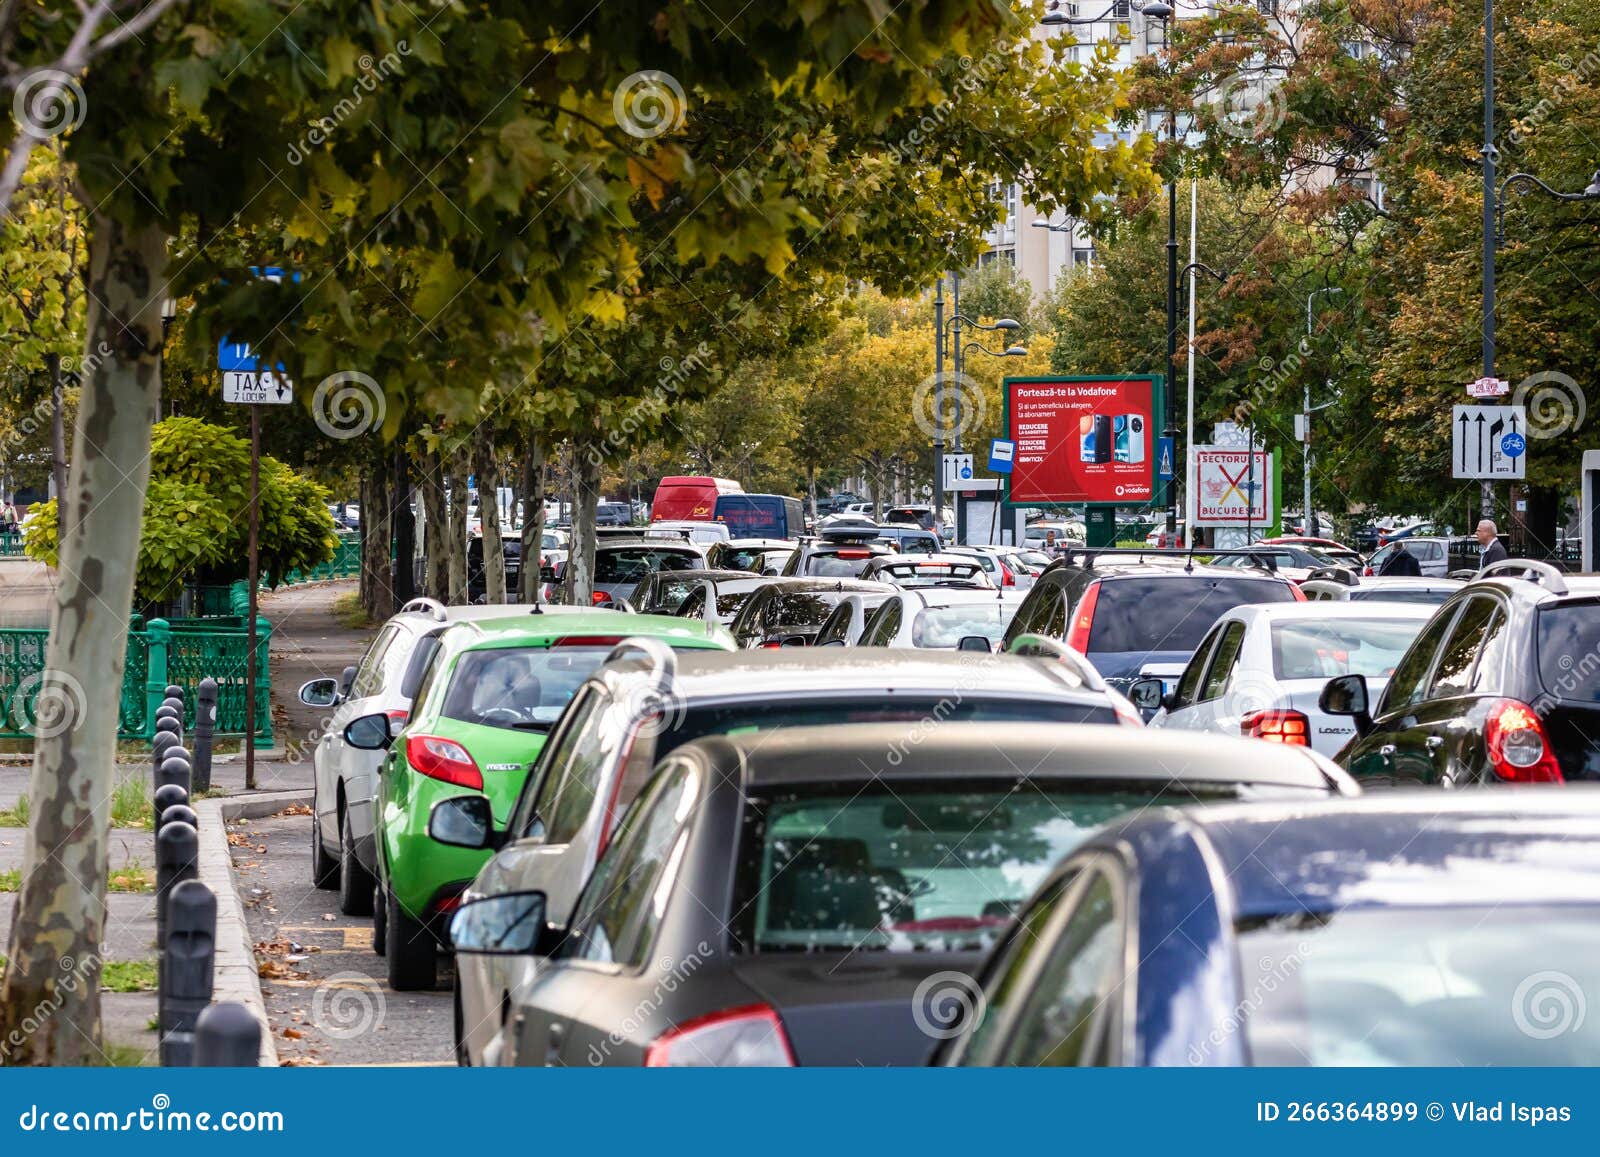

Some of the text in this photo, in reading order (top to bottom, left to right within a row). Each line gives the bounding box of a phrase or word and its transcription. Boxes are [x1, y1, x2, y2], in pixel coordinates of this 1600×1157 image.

[234, 374, 267, 391] TAX
[234, 392, 267, 401] 7 LOCURI
[1017, 386, 1117, 397] Portează-te la Vodafone
[1202, 455, 1250, 463] SECTORU
